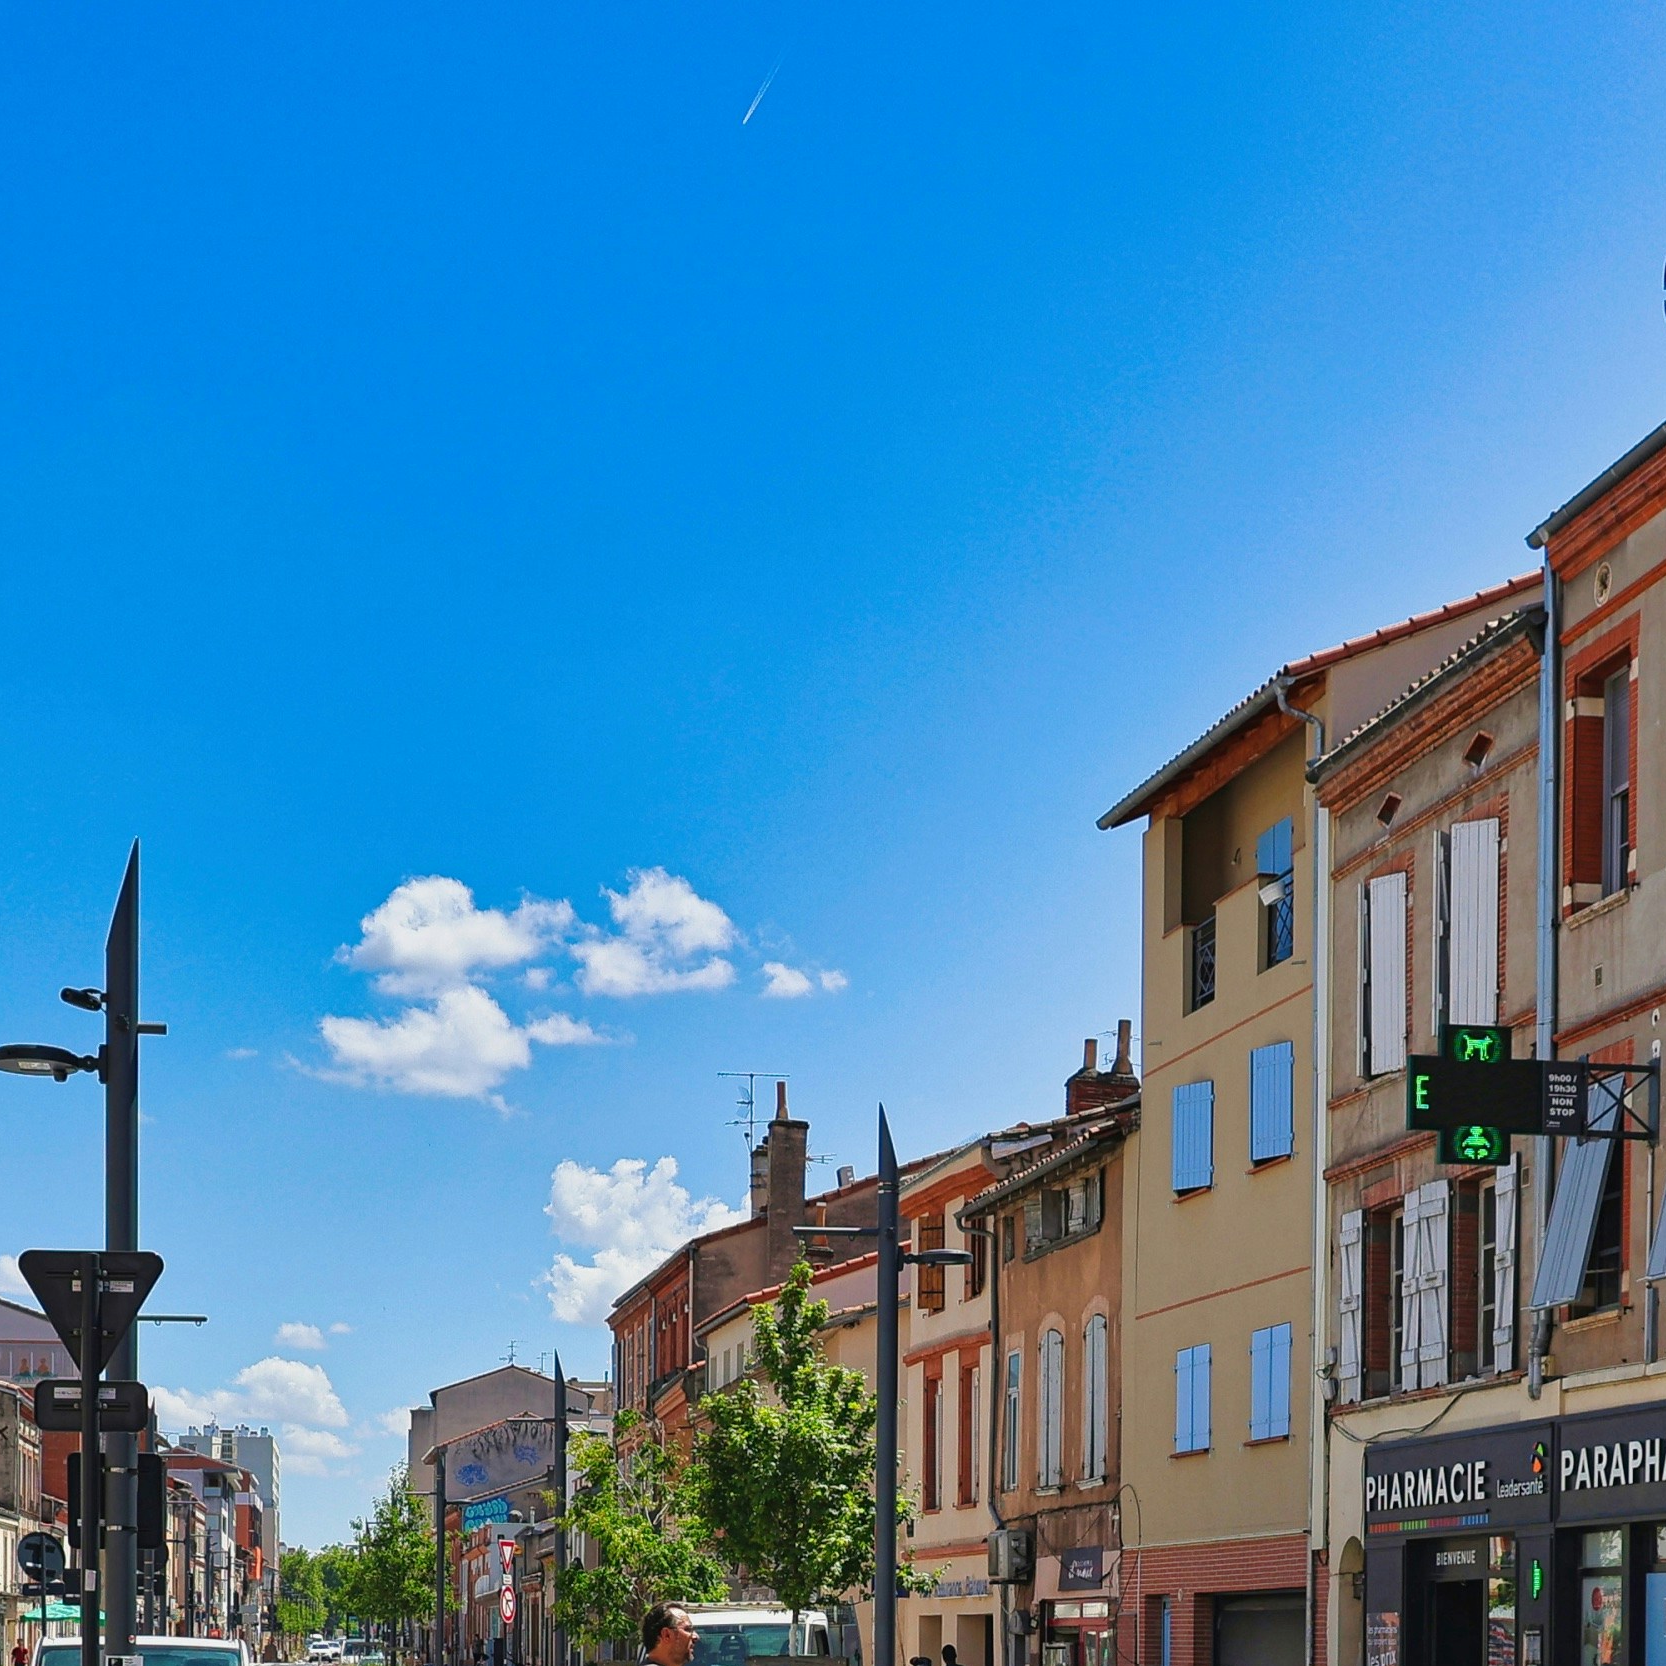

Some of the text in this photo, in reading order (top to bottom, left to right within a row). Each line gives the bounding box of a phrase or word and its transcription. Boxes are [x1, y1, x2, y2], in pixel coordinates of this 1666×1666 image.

[1548, 1073, 1572, 1083] 9h00
[1548, 1084, 1577, 1093] 19h30
[1551, 1097, 1574, 1106] NON
[1549, 1107, 1576, 1117] STOP
[1365, 1460, 1486, 1513] PHARMACIE
[1435, 1549, 1476, 1567] BIENVENUE
